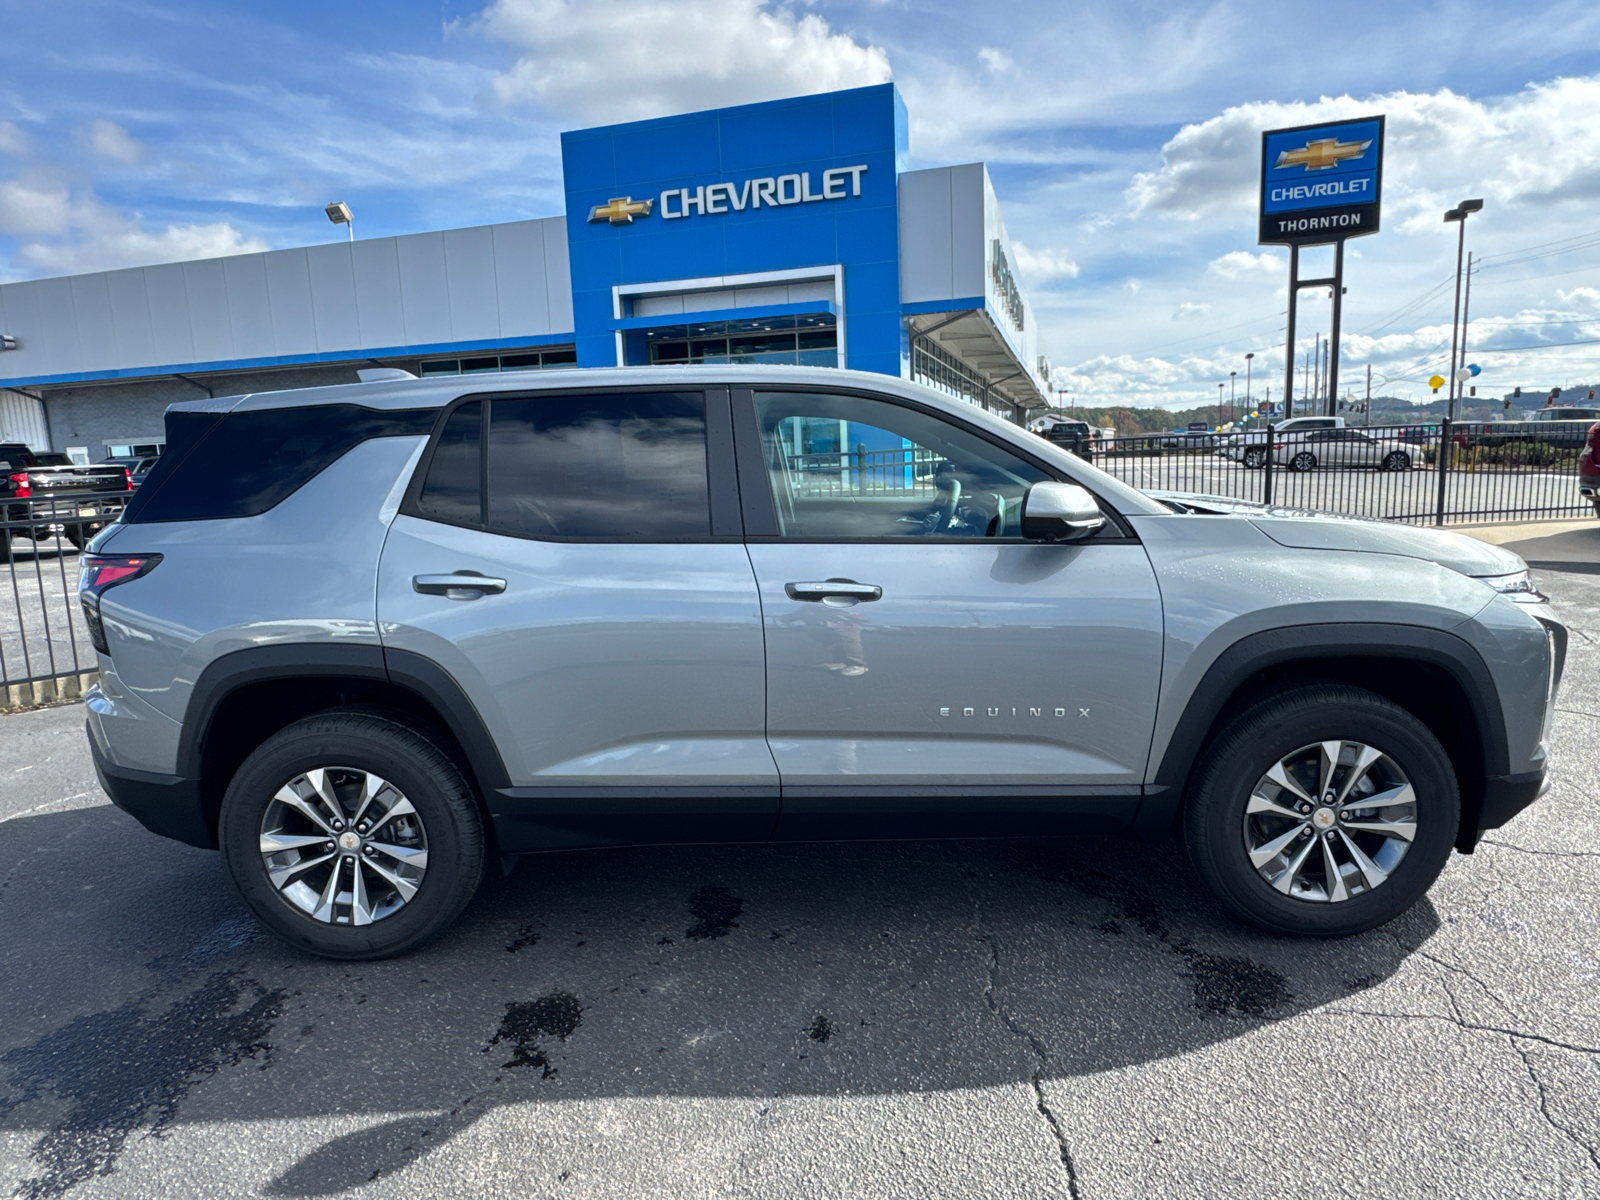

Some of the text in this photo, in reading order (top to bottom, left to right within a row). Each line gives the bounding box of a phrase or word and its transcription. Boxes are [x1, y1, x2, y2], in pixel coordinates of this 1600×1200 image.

[660, 164, 868, 219] CHEVROLET
[1271, 178, 1370, 201] CHEVROLET
[1279, 213, 1361, 232] THORNTON
[939, 707, 1091, 718] EQUINOX
